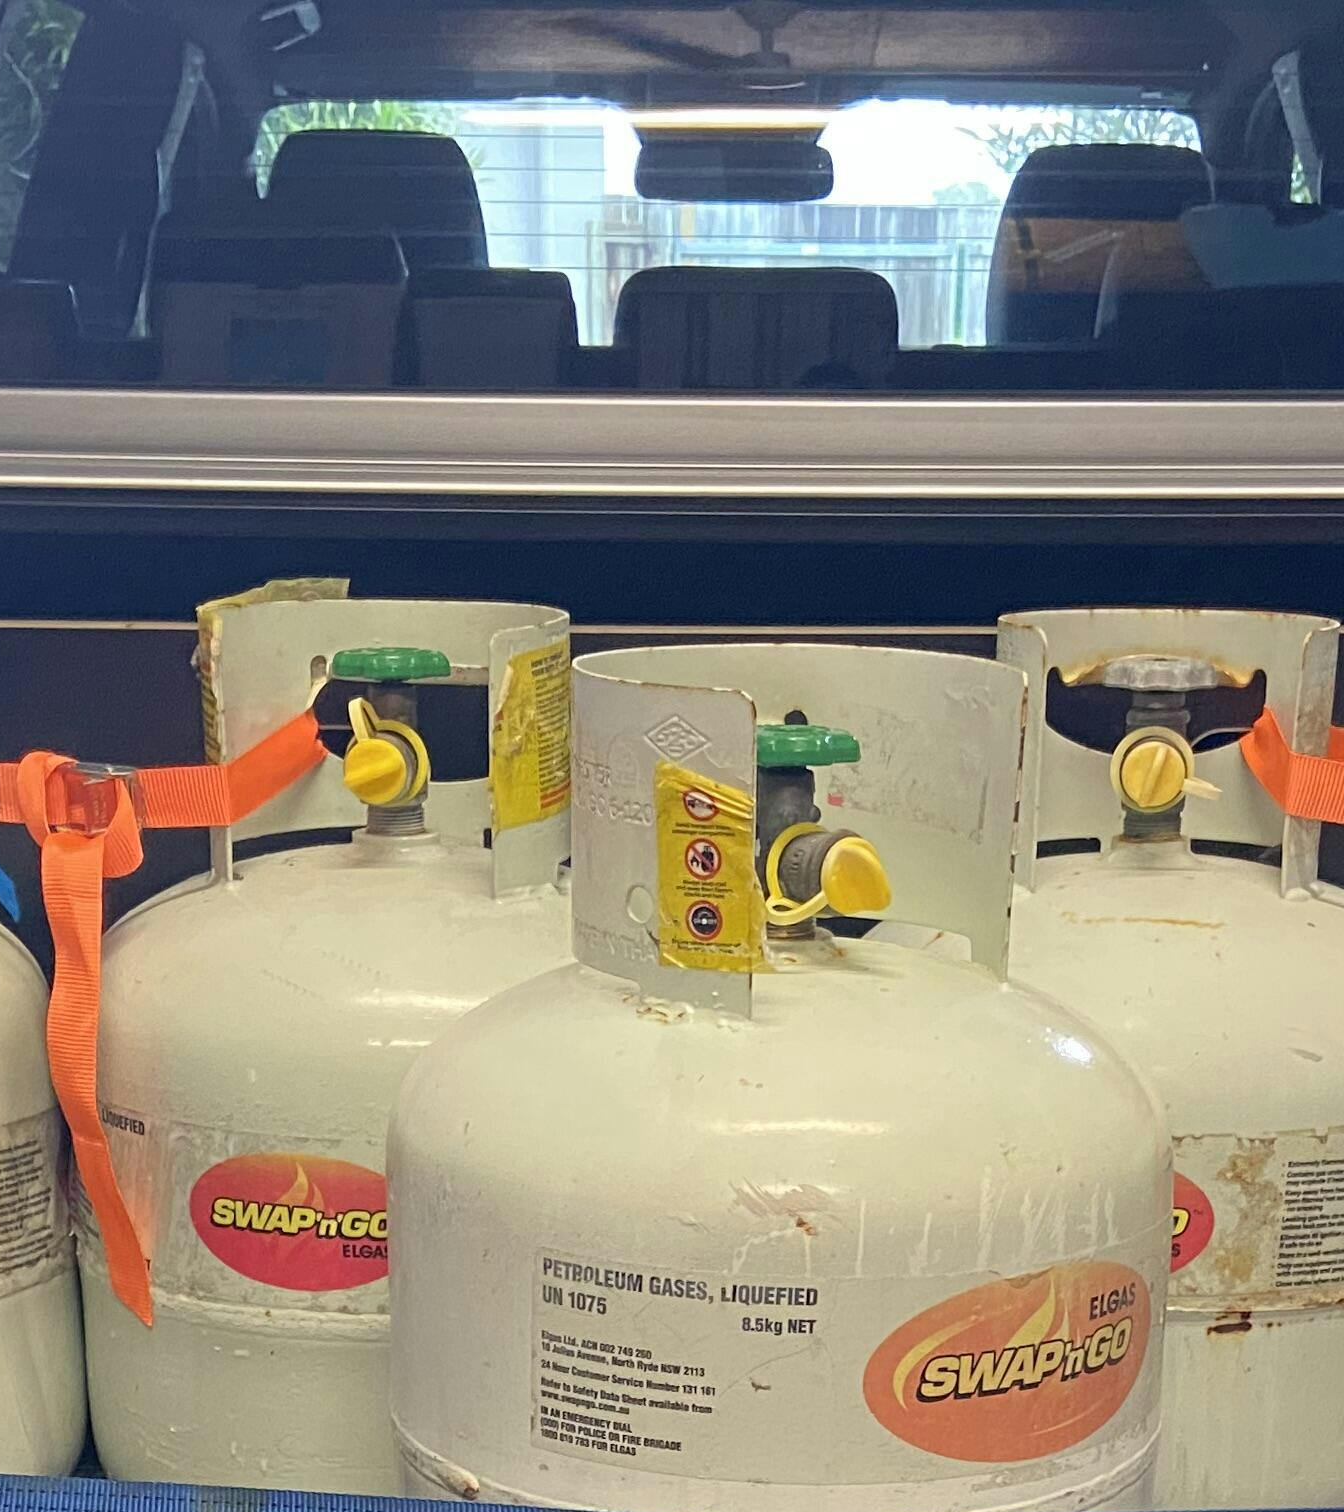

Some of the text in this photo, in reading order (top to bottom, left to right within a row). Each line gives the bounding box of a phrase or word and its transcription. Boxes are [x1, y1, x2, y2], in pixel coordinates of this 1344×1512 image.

[543, 1257, 818, 1307] PETROLEUM GASES, LIQUEFIED
[542, 1284, 607, 1315] UN 1075
[1089, 1282, 1136, 1320] ELGAS
[741, 1317, 817, 1335] 8.5kg NET
[581, 1339, 598, 1350] ACN
[600, 1342, 615, 1354] 002
[617, 1345, 634, 1357] 749
[541, 1359, 551, 1369] 24
[571, 1366, 610, 1382] Customer
[611, 1374, 644, 1388] Service
[646, 1380, 680, 1393] Number
[682, 1384, 698, 1395] 131
[700, 1386, 716, 1397] 161
[611, 1356, 635, 1369] North
[637, 1360, 659, 1373] Ryde
[660, 1363, 681, 1375] NSW
[683, 1366, 706, 1378] 2113
[573, 1384, 599, 1400] Safety
[600, 1389, 620, 1402] Data
[621, 1393, 647, 1407] Sheet
[648, 1399, 690, 1412] available
[691, 1403, 713, 1414] from
[550, 1407, 561, 1418] AN
[562, 1410, 612, 1430] EMERGENCY
[613, 1421, 633, 1434] DIAL
[561, 1422, 576, 1434] FOR
[578, 1426, 607, 1440] POLICE
[608, 1430, 621, 1442] OR
[622, 1433, 642, 1446] FIRE
[643, 1436, 682, 1452] BRIGADE
[591, 1439, 608, 1451] FOR
[610, 1442, 637, 1456] ELGAS
